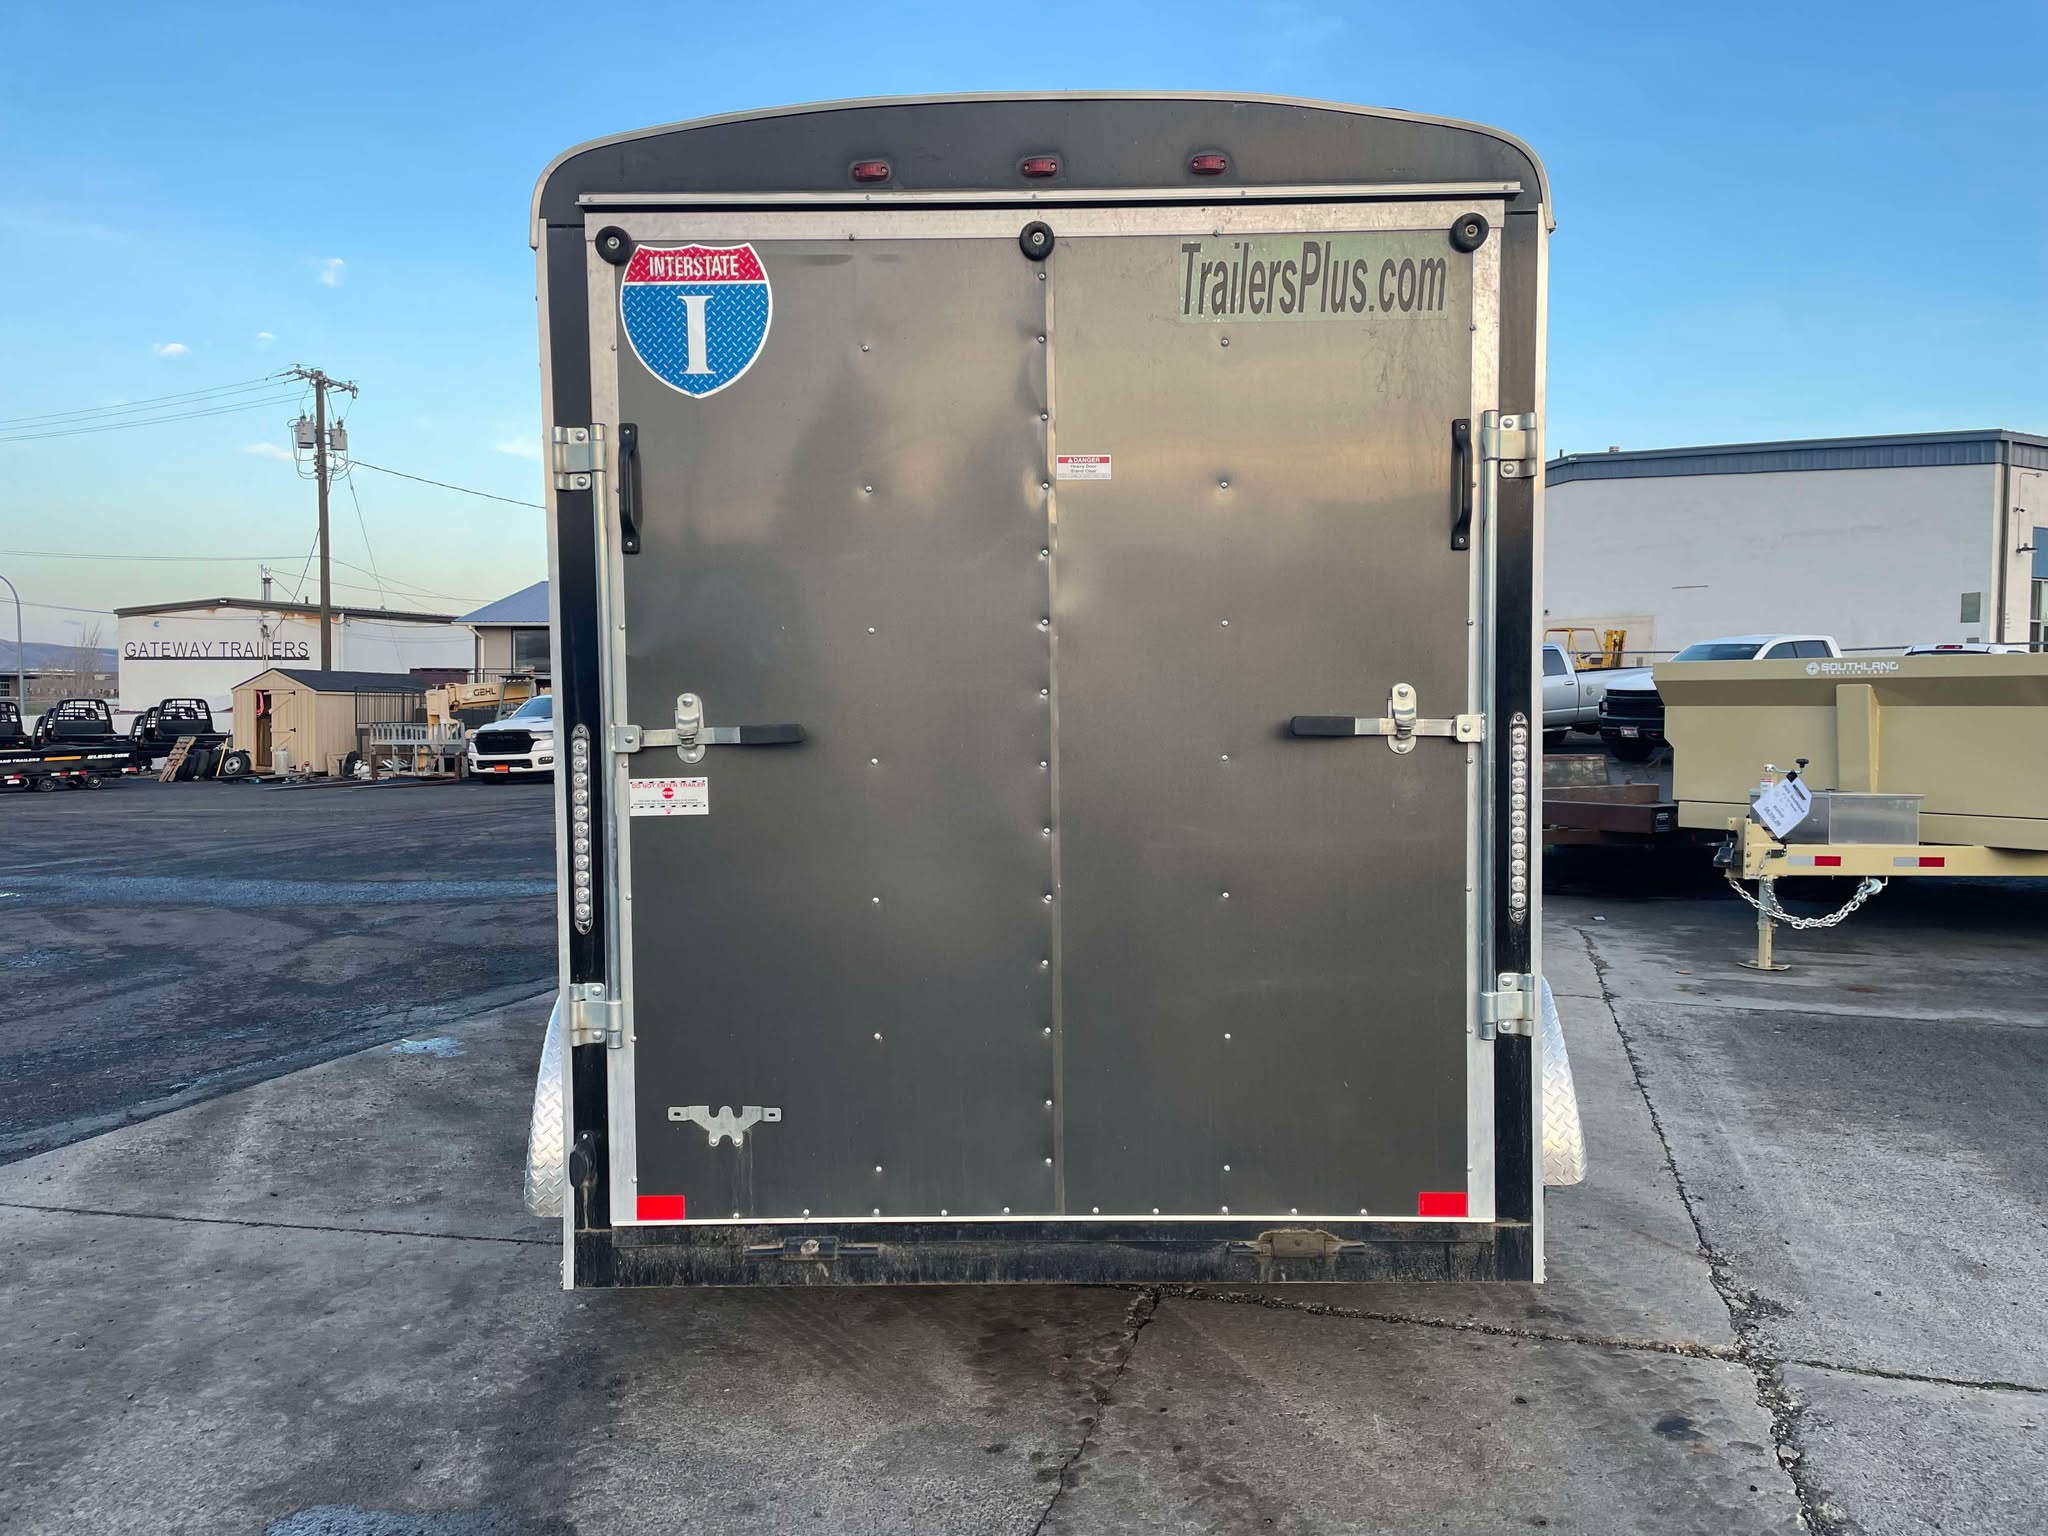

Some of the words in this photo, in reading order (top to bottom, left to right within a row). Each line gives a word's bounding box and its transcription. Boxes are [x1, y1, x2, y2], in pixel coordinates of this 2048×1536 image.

[649, 255, 739, 277] INTERSTATE
[1181, 241, 1447, 315] TrailersPlus.com
[677, 295, 717, 375] I
[125, 641, 213, 658] GATEWAY
[1821, 661, 1899, 671] SOUTHLAND
[473, 688, 496, 696] GEHL
